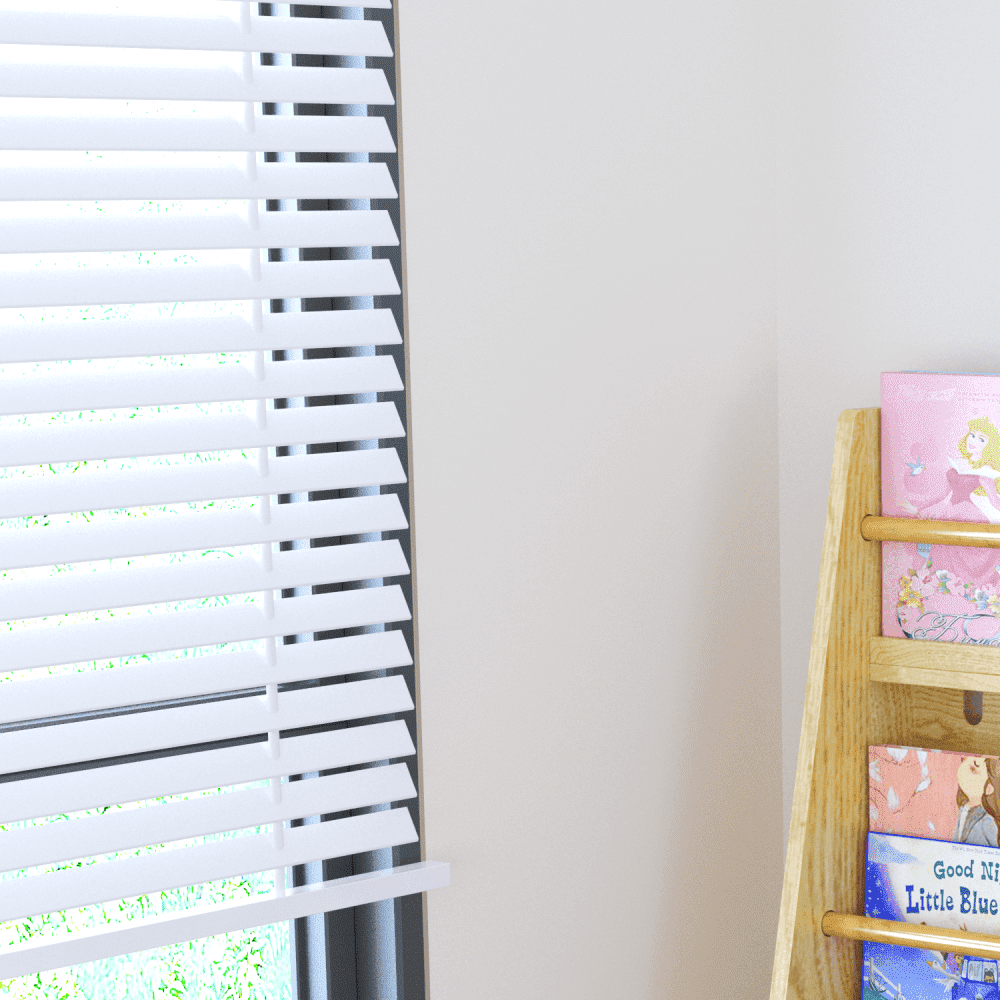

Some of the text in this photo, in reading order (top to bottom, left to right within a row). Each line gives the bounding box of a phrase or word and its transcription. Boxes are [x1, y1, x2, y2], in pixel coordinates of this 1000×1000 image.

[933, 859, 975, 880] Good
[905, 884, 954, 914] Little
[959, 886, 998, 916] Blue
